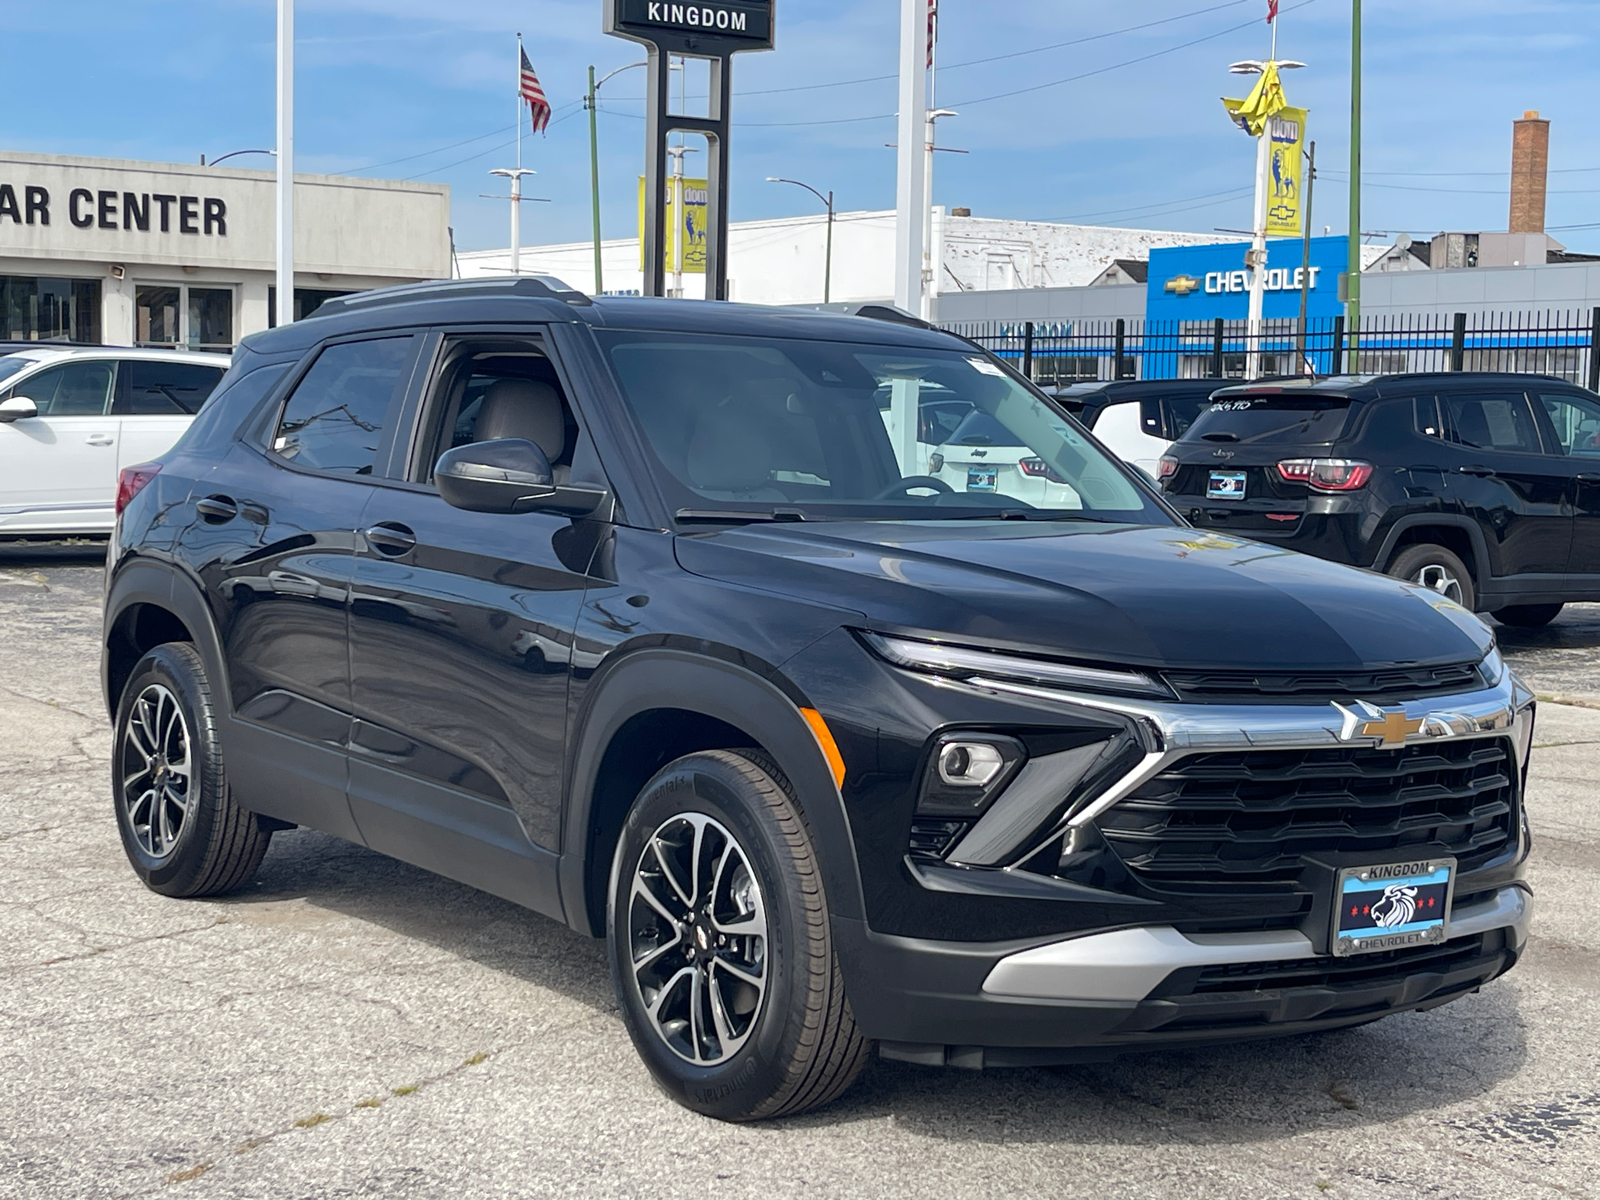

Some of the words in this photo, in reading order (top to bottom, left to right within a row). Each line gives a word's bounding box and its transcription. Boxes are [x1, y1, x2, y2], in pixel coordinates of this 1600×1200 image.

[648, 2, 746, 31] KINGDOM
[0, 184, 50, 225] AR
[69, 188, 227, 236] CENTER
[1369, 862, 1430, 880] KINGDOM
[1359, 933, 1421, 950] CHEVROLET
